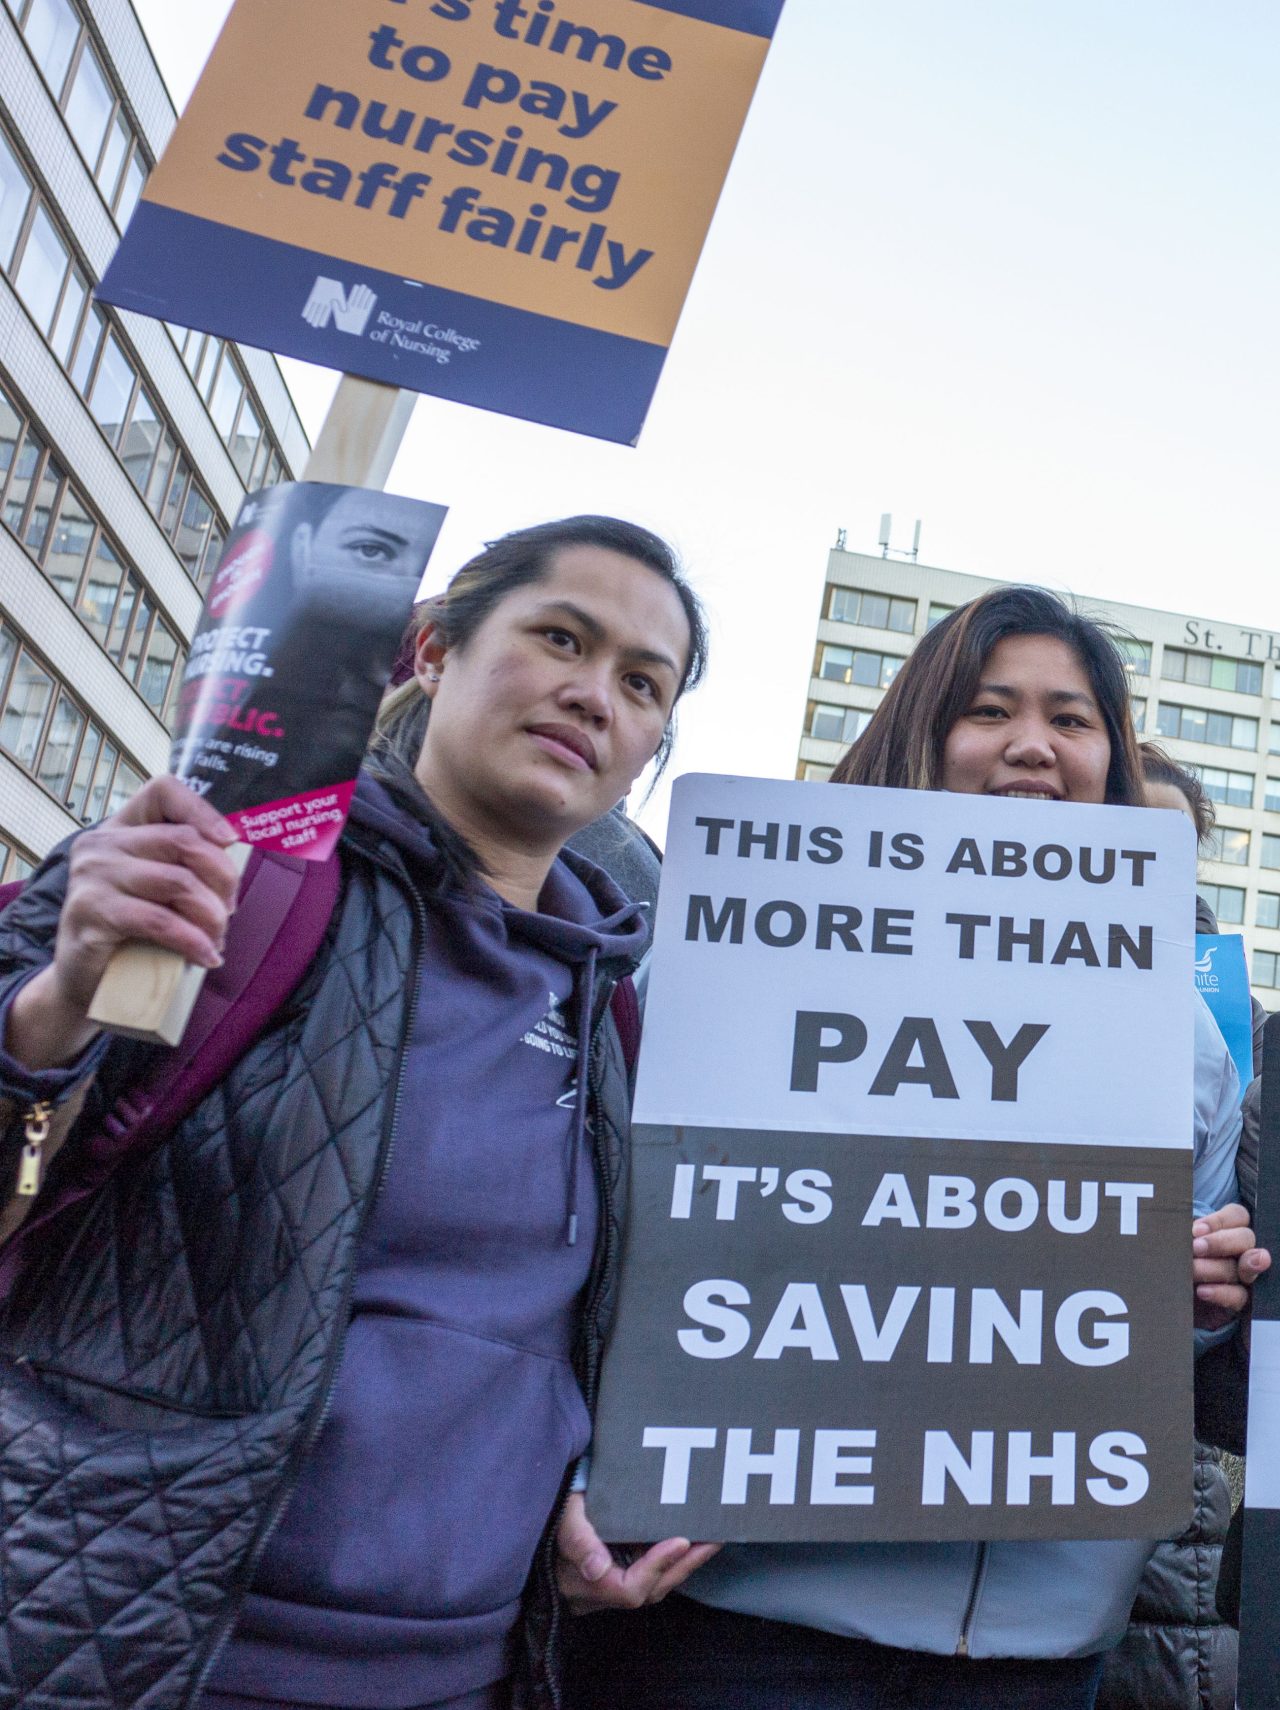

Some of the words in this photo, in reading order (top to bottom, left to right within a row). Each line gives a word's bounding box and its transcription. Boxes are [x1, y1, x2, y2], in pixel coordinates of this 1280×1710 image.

[493, 0, 672, 81] time
[367, 24, 452, 82] to
[461, 62, 619, 139] pay
[303, 83, 622, 213] nursing
[215, 131, 433, 220] staff
[437, 186, 655, 291] fairly
[369, 328, 389, 343] of
[389, 332, 451, 365] Nursing
[376, 310, 423, 334] Royal
[423, 323, 481, 352] College
[1183, 620, 1223, 651] St.
[233, 742, 280, 767] rising
[240, 801, 302, 829] Support
[303, 793, 339, 814] your
[246, 821, 284, 842] local
[285, 807, 344, 832] nursing
[281, 826, 317, 849] staff
[694, 816, 844, 864] THIS
[868, 830, 925, 871] IS
[945, 837, 1157, 887] ABOUT
[684, 894, 915, 956] MORE
[945, 912, 1154, 970] THAN
[789, 1009, 1052, 1103] PAY
[669, 1163, 833, 1225] IT'S
[861, 1173, 1154, 1236] ABOUT
[676, 1279, 1130, 1367] SAVING
[642, 1427, 877, 1505] THE
[921, 1430, 1150, 1507] NHS
